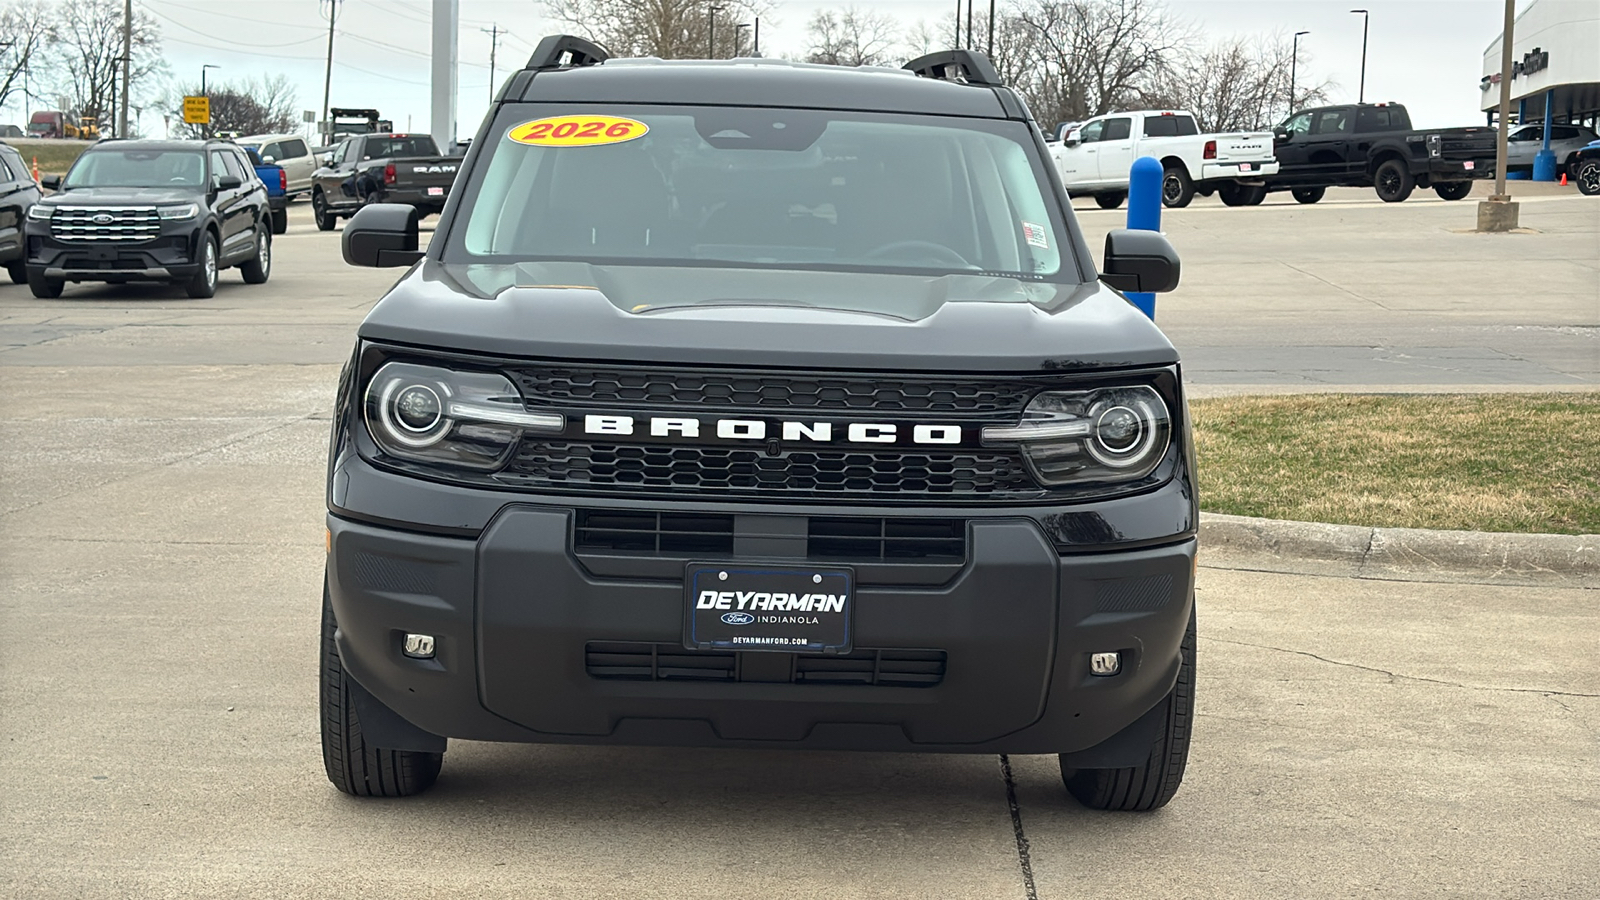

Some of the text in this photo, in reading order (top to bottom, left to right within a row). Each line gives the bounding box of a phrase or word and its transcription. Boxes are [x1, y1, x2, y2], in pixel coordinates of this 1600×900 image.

[522, 122, 634, 140] 2026
[413, 166, 456, 174] RAM
[584, 414, 962, 444] BRONCO
[695, 590, 847, 613] DEYARMAN
[725, 613, 819, 625] Ford INDIANOLA
[732, 636, 808, 646] DEYARMANFORD.COM
